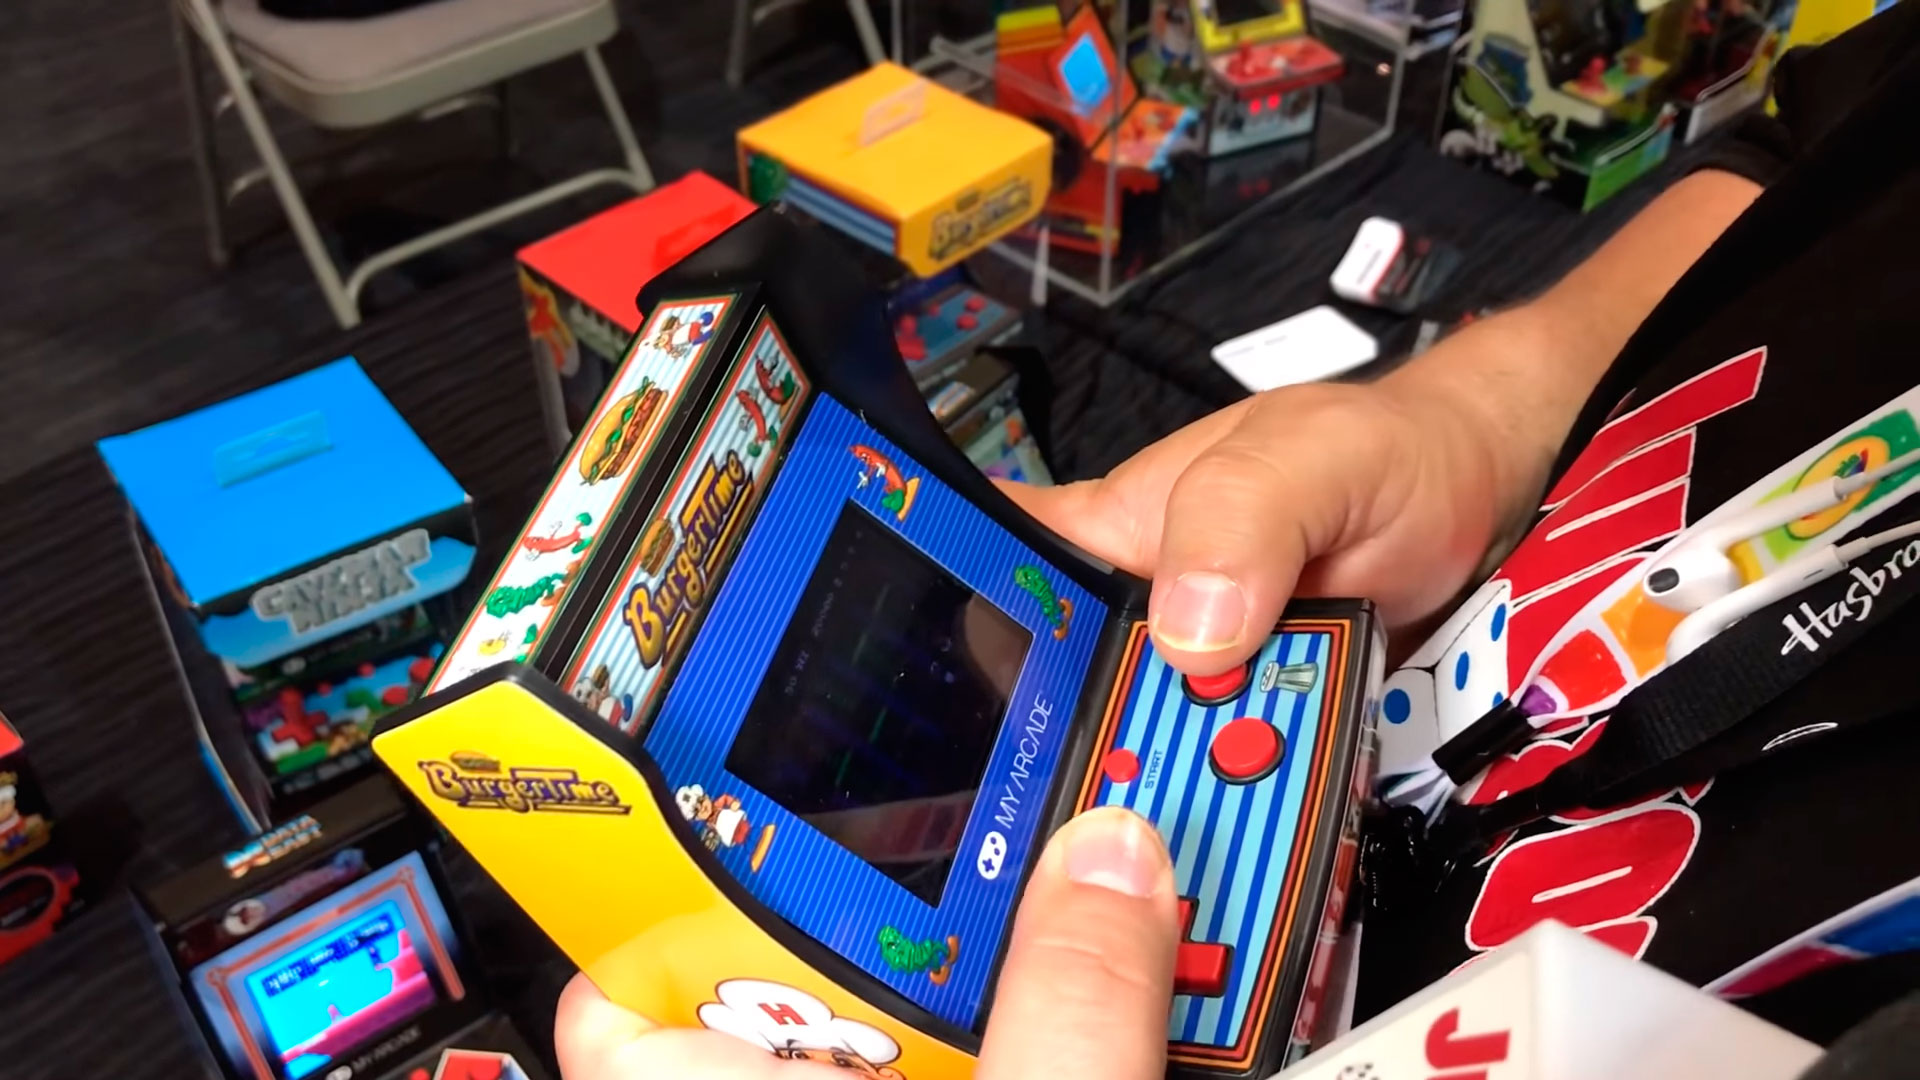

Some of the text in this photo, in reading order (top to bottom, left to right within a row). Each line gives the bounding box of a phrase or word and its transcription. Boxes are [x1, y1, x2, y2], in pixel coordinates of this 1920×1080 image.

[994, 693, 1053, 830] MY ARCADE
[1144, 749, 1163, 790] START
